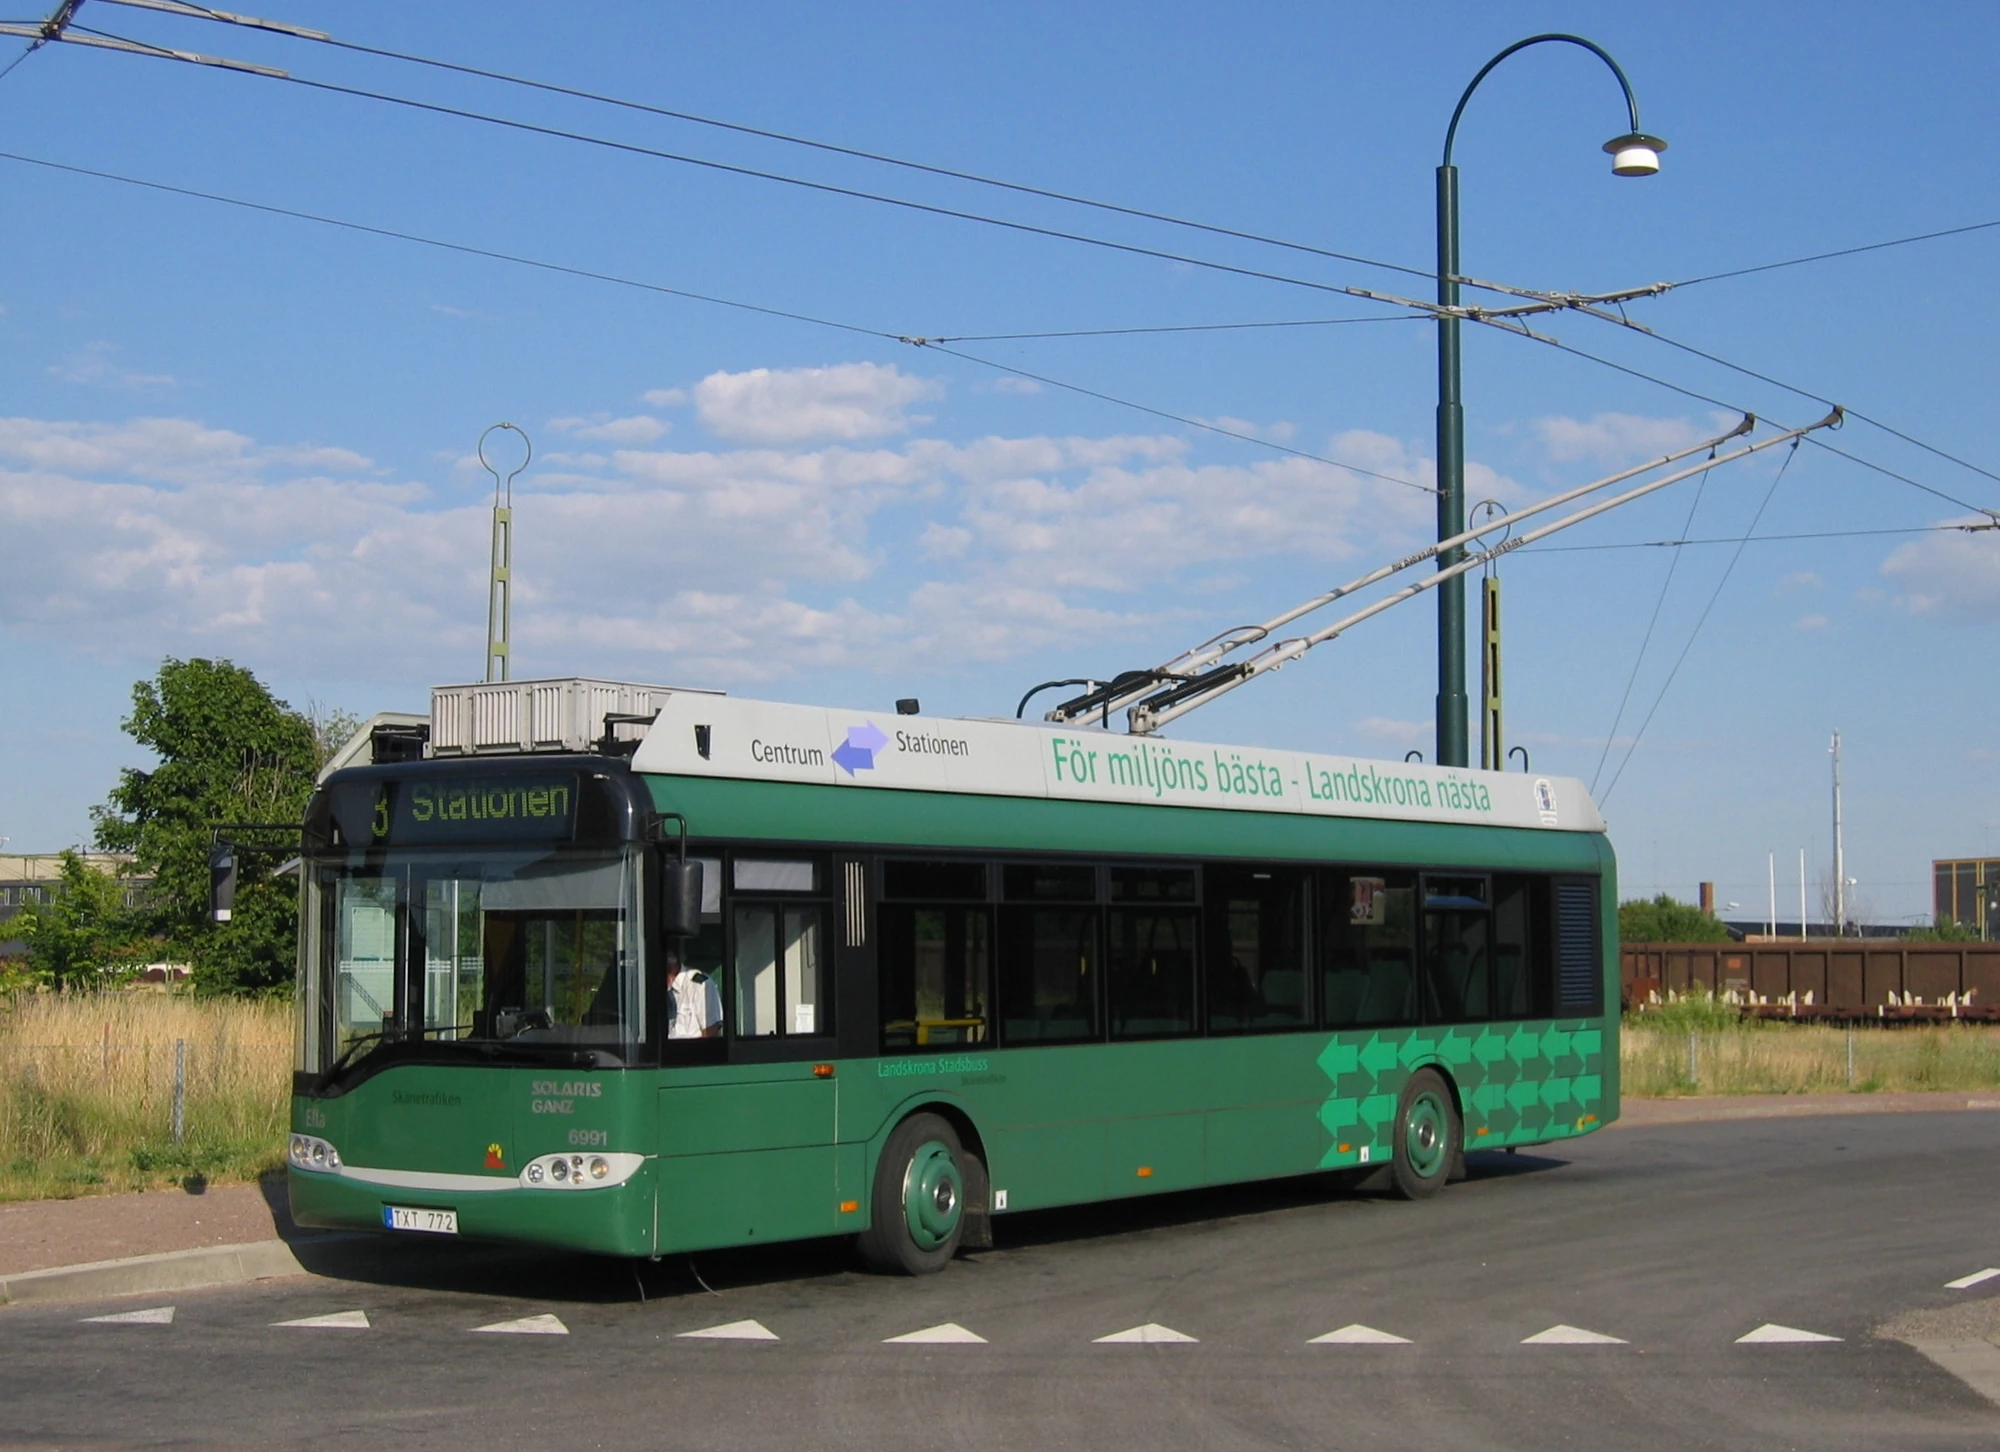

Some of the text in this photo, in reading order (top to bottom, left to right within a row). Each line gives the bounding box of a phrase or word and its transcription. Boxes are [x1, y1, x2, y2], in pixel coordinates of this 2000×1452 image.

[751, 739, 824, 766] Centrum
[896, 730, 969, 757] Stationen
[1052, 738, 1097, 783] För
[1108, 744, 1208, 798] miljöns
[1213, 750, 1283, 797] bästa
[1306, 760, 1432, 808] Landskrona
[1436, 774, 1491, 811] nästa
[371, 783, 568, 836] 3 Stationen
[878, 1056, 988, 1077] Landskrona Stadsbuss
[532, 1080, 602, 1097] SOLARIS
[532, 1100, 574, 1114] GANZ
[568, 1129, 607, 1146] 6991
[394, 1210, 453, 1231] TXT 772
